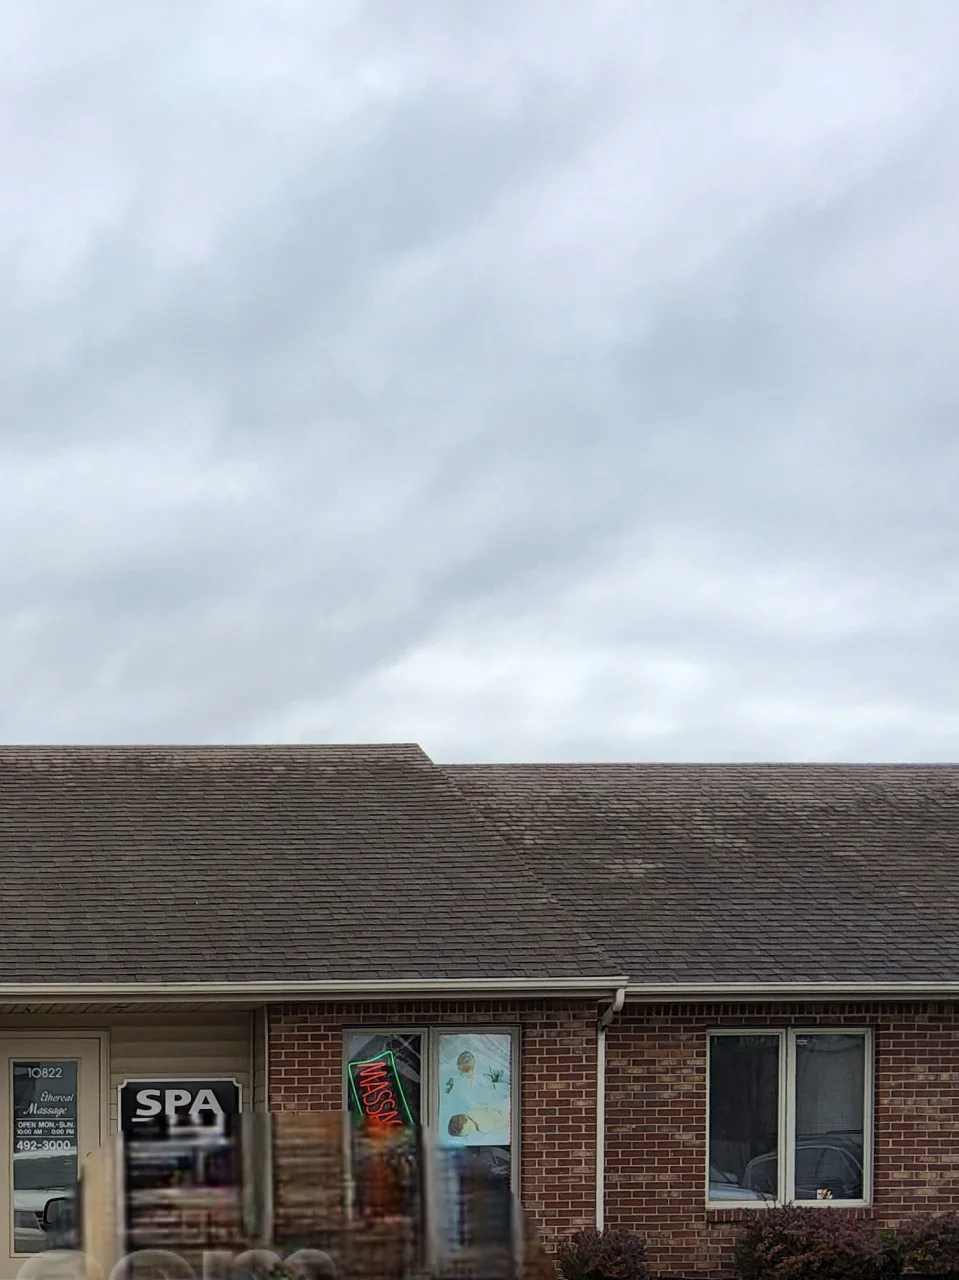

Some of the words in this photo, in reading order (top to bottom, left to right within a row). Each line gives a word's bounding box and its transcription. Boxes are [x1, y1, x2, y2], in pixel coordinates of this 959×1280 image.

[27, 1067, 63, 1078] 10822
[40, 1091, 74, 1102] Ethereal
[356, 1061, 404, 1124] MASSA
[135, 1088, 226, 1117] SPA
[23, 1103, 67, 1117] Massage
[16, 1140, 71, 1151] 492-3000
